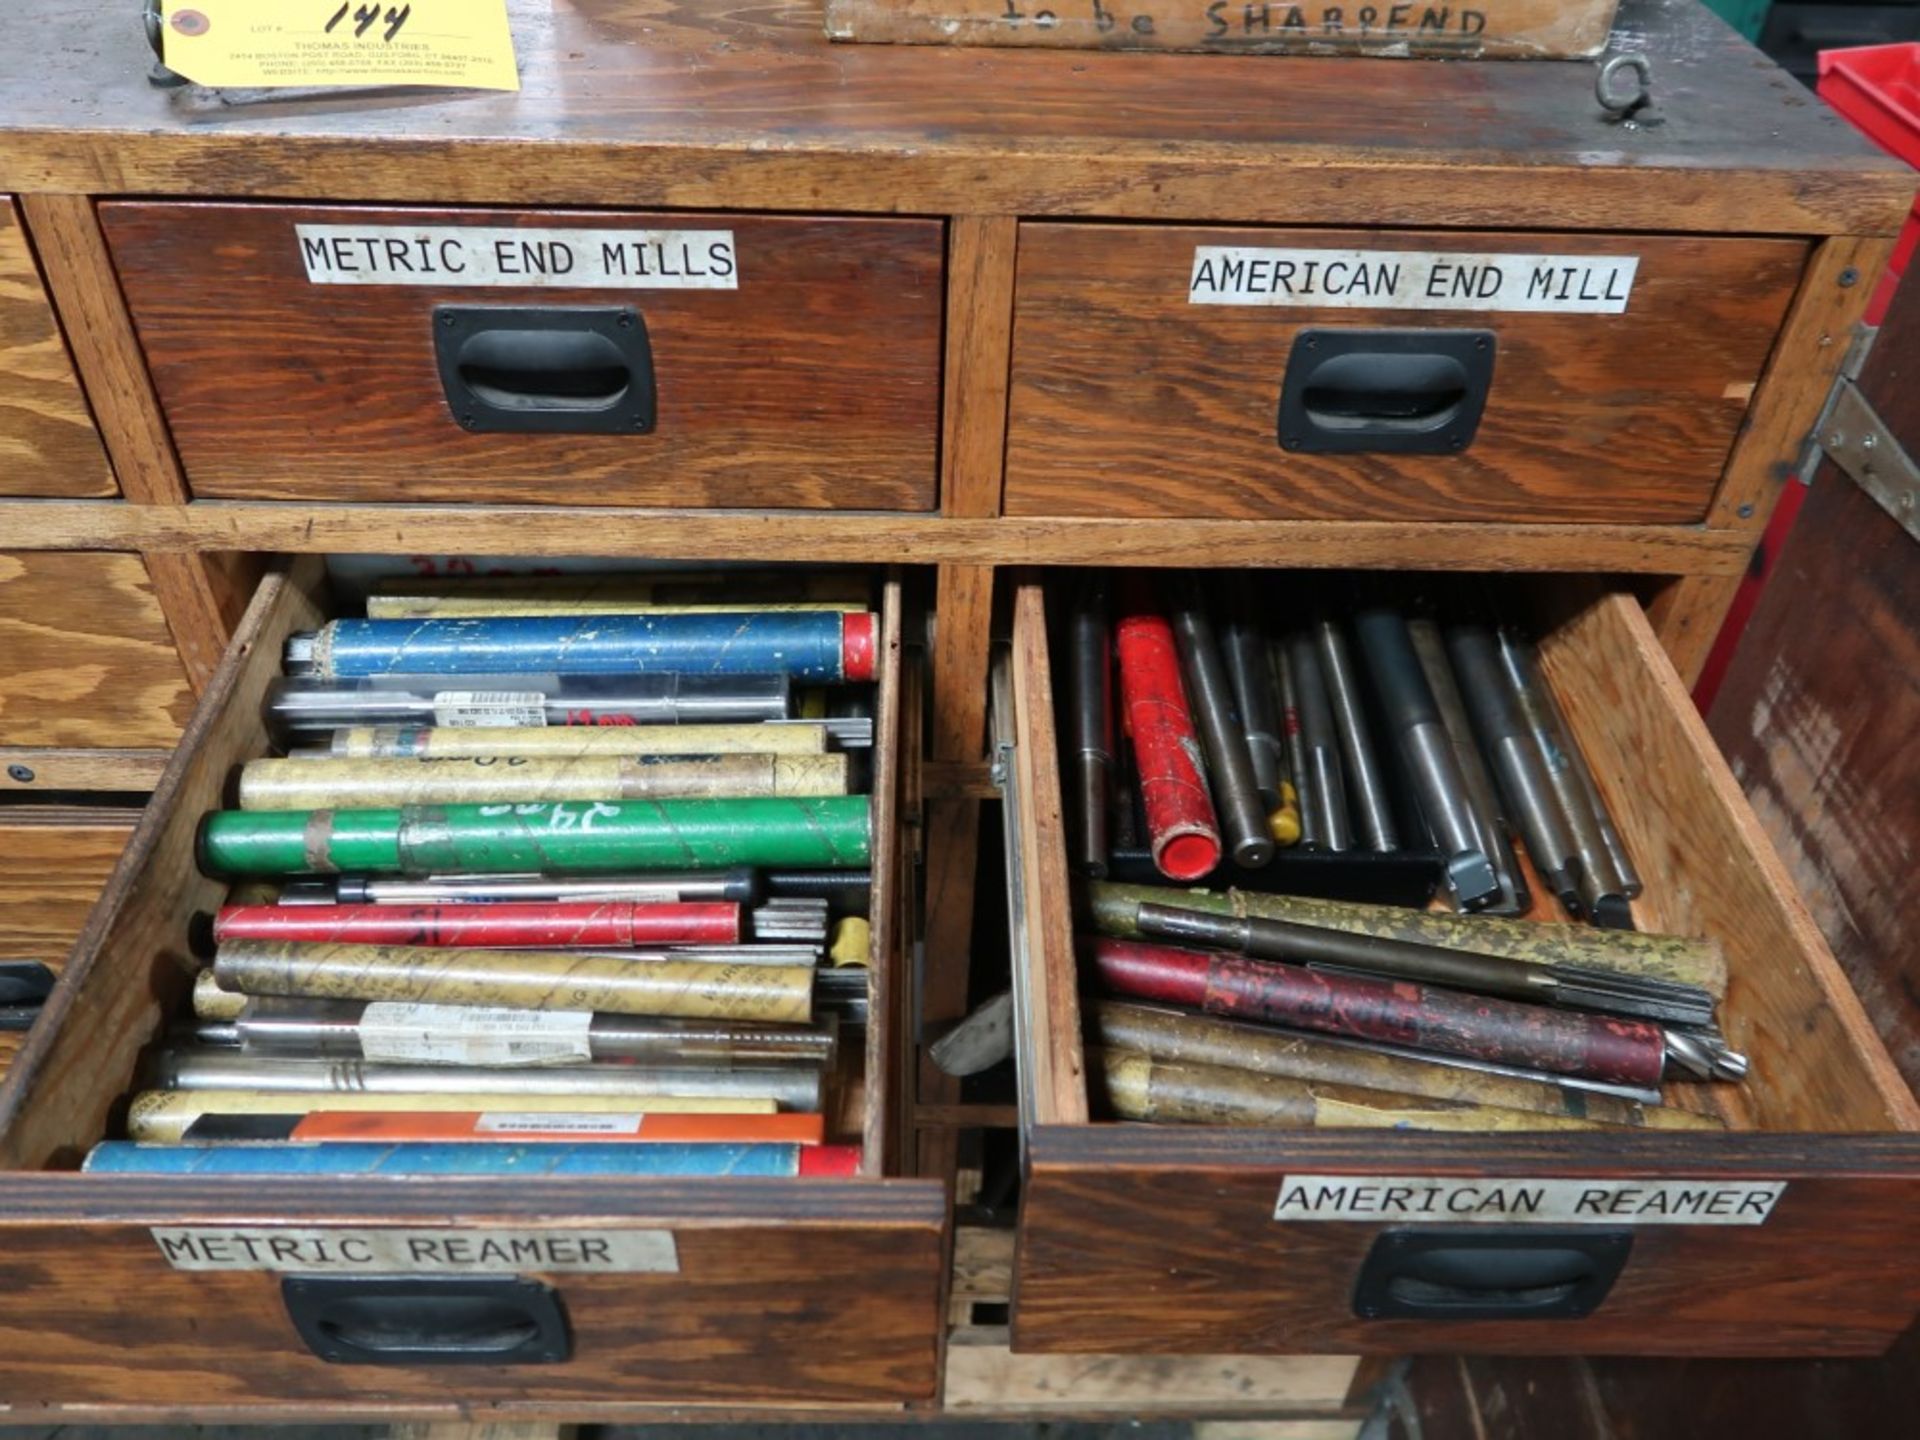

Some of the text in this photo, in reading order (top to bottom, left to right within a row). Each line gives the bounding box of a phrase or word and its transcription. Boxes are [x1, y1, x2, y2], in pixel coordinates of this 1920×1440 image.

[324, 0, 411, 43] 144
[1001, 0, 1487, 37] to be SHARPEND
[294, 41, 431, 51] THOMAS INDUSTRIES
[302, 237, 734, 277] METRIC END MILLS
[1190, 258, 1626, 301] AMERICAN END MILL
[1278, 1185, 1776, 1216] AMERICAN REAMER
[161, 1236, 613, 1265] METRIC REAMER
